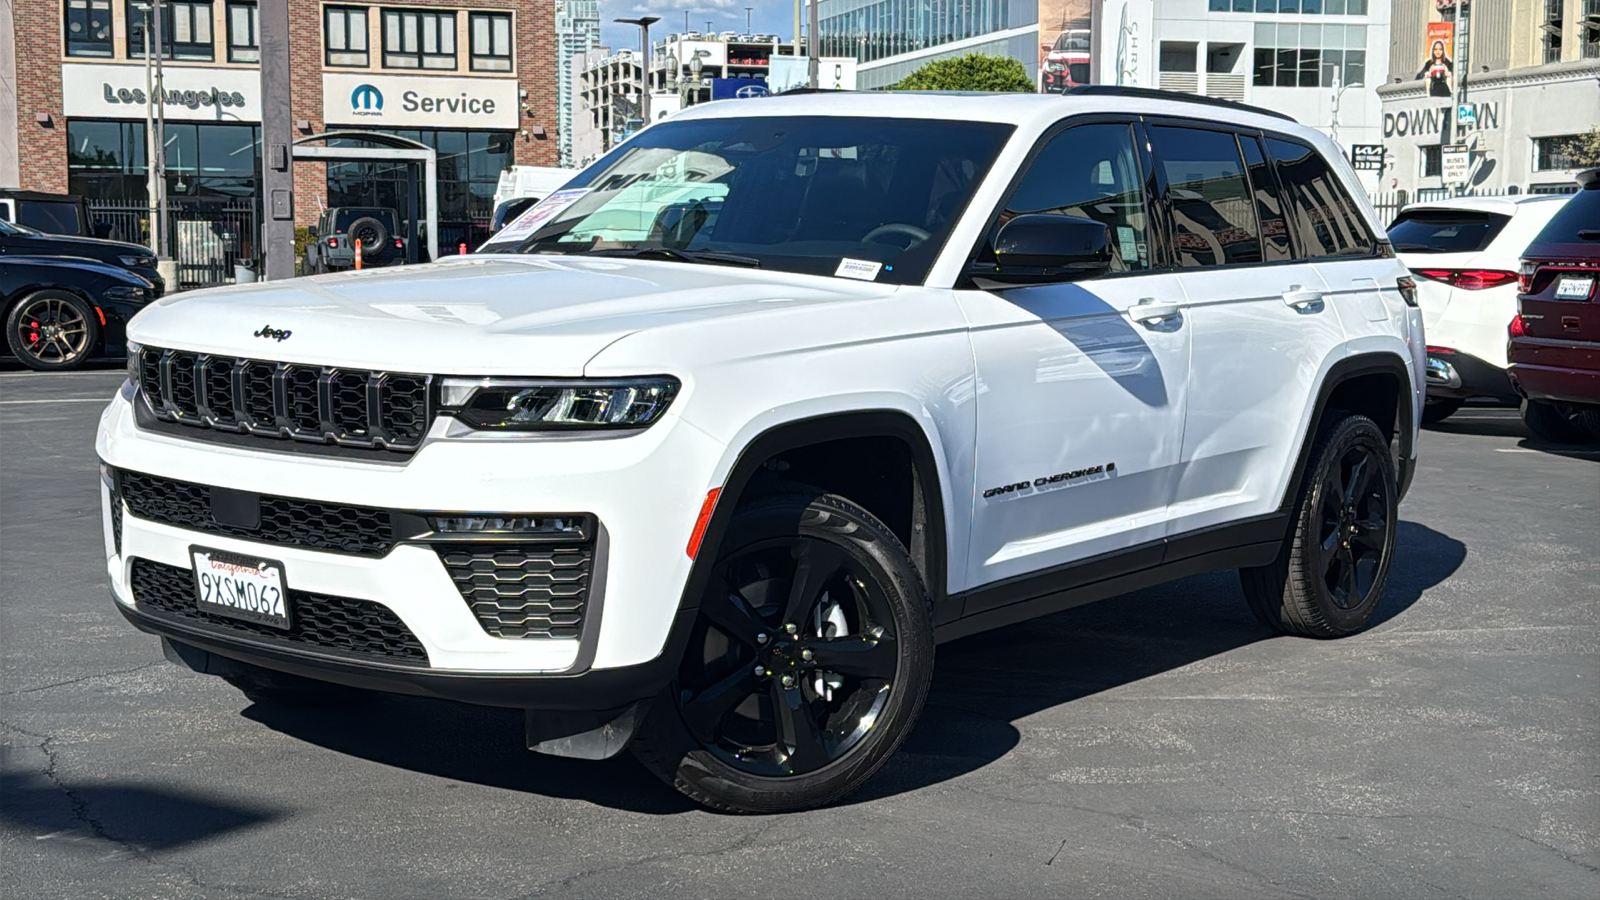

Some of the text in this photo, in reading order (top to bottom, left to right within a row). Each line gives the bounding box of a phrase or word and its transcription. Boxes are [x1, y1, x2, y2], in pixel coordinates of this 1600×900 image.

[103, 83, 246, 110] Los Angeles
[402, 90, 496, 114] Service
[1384, 101, 1499, 138] DOWNTWN
[253, 324, 293, 343] Jeep
[983, 465, 1103, 498] GRAND CHEROKEE
[201, 572, 283, 616] 9XSM062
